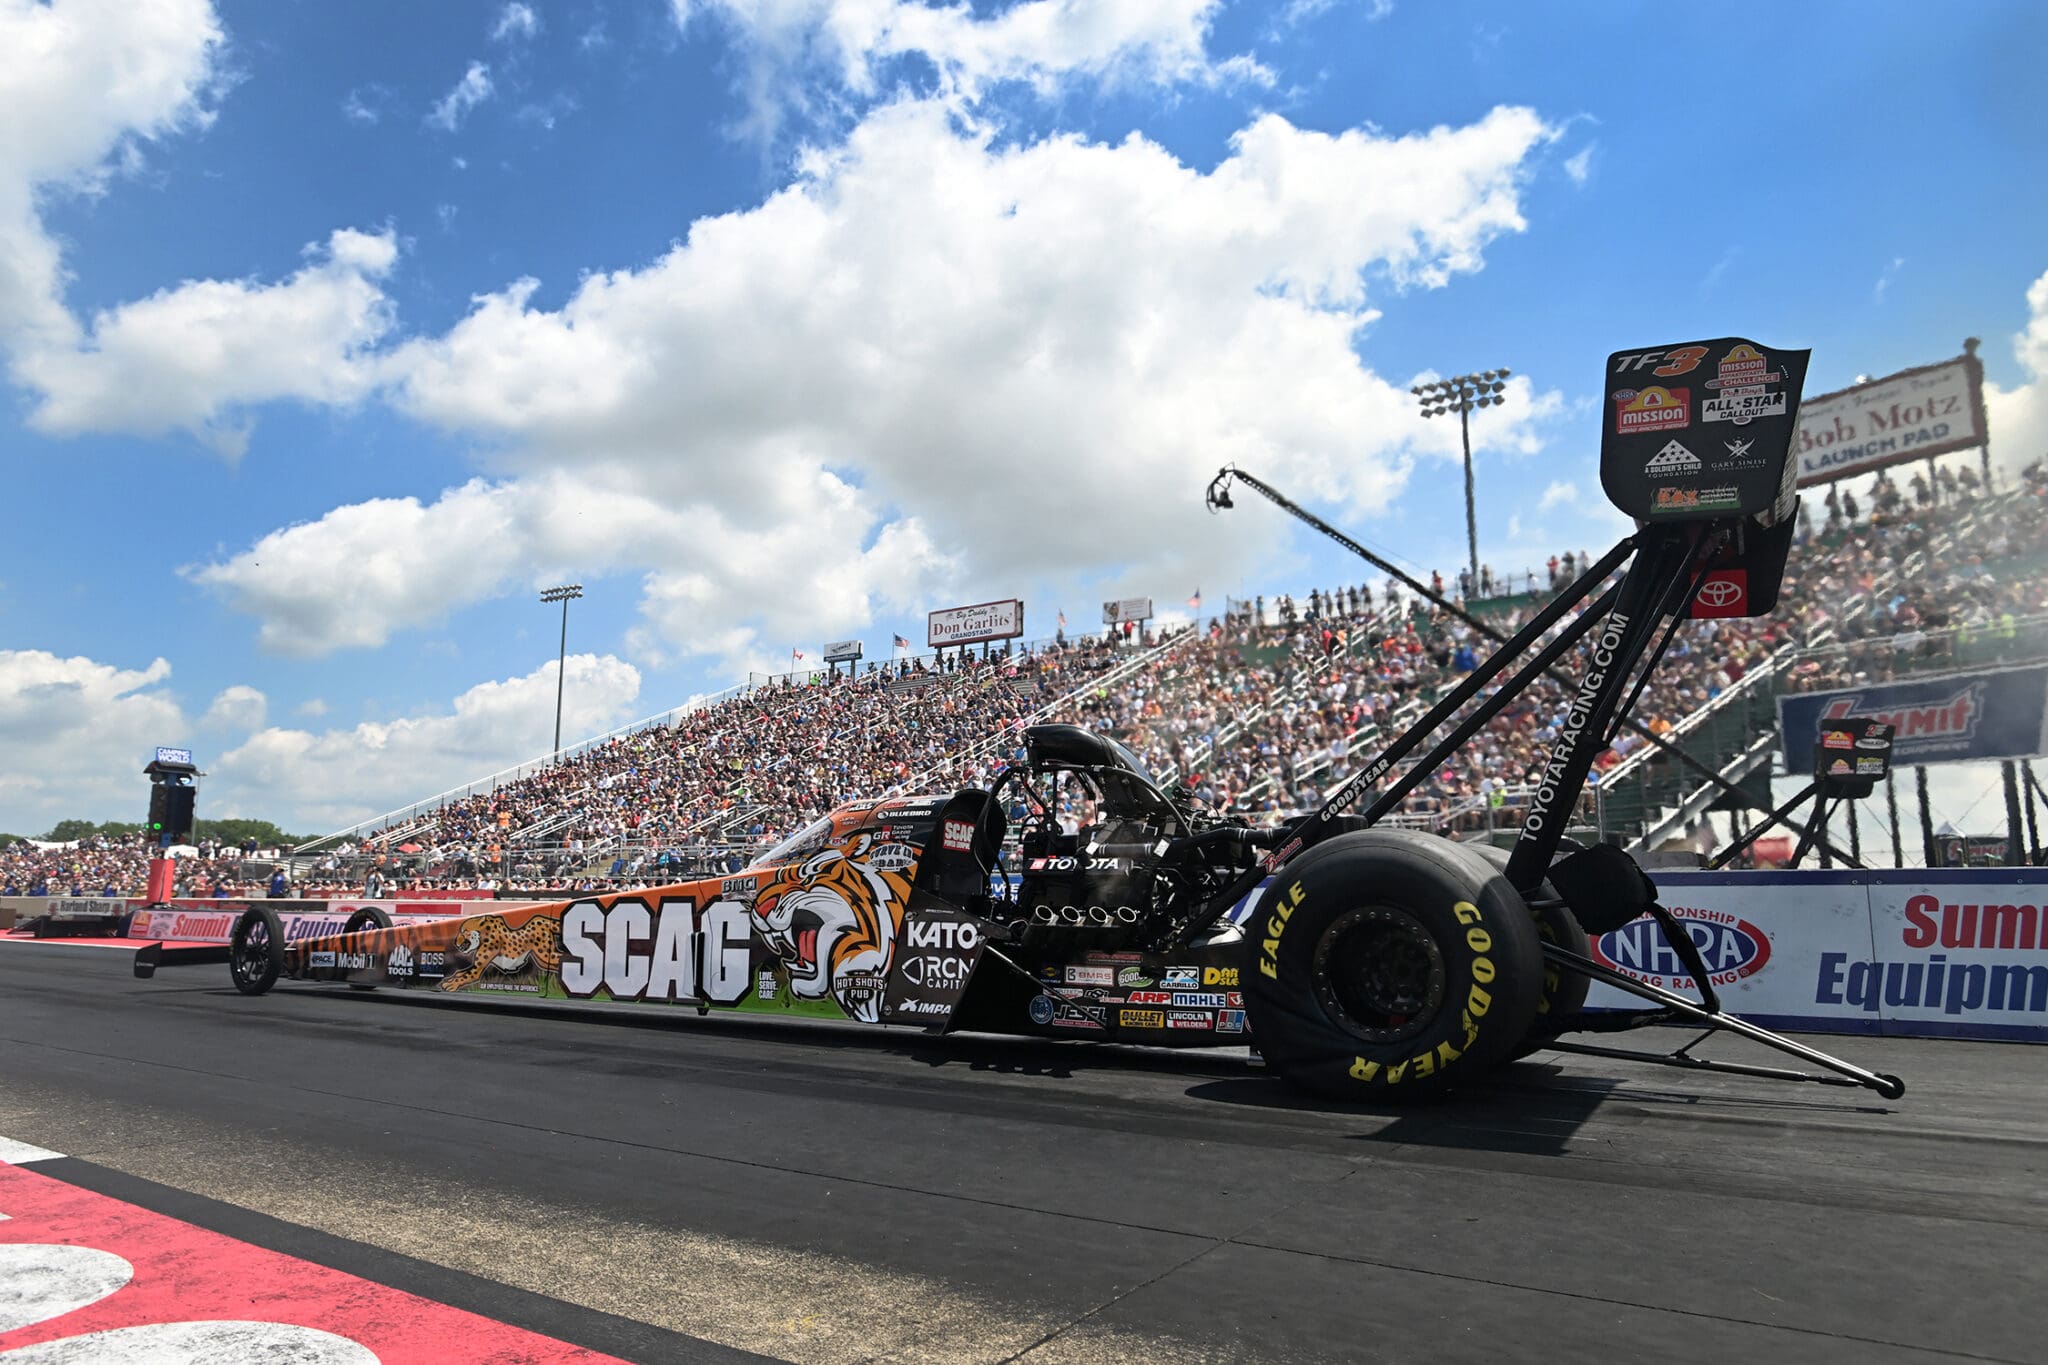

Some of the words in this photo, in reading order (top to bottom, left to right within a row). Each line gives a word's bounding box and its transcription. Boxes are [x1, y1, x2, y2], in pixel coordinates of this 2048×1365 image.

[1616, 346, 1709, 377] TF3
[1724, 375, 1777, 386] CHALLENGE
[1720, 408, 1765, 419] CALLOUT
[1867, 395, 1961, 436] Motz
[1804, 436, 1897, 472] LAUNCH
[1903, 422, 1950, 447] PAD
[1650, 464, 1682, 473] SOLDIER'S
[1683, 462, 1702, 470] CHILD
[1711, 461, 1734, 469] GARY
[1648, 470, 1699, 478] FOUNDATION
[955, 611, 967, 619] Big
[968, 608, 988, 617] Daddy
[933, 623, 960, 636] Don
[950, 628, 993, 640] GRANDSTAND
[1519, 611, 1631, 842] TOYOTARACING.COM
[158, 754, 190, 764] WORLD
[1320, 758, 1390, 823] GOODYEAR
[889, 810, 932, 818] BLUEBIRD
[873, 831, 891, 840] GR
[945, 822, 975, 842] SCAG
[1048, 858, 1120, 870] TOOTA
[172, 914, 231, 938] Summit
[1902, 894, 2048, 951] Sum
[907, 921, 978, 950] KATO
[1259, 880, 1308, 980] EAGLE
[561, 900, 751, 1002] SCAG
[1614, 921, 1744, 974] NHRA
[338, 952, 366, 969] Mobil
[388, 945, 414, 967] MAC
[421, 952, 445, 965] BOSS
[388, 967, 414, 976] TOOLS
[837, 978, 852, 989] HOT
[855, 978, 884, 989] SHOTS
[926, 978, 966, 989] CAPIT
[1672, 971, 1737, 990] RANG
[851, 989, 869, 999] PUB
[1129, 993, 1171, 1003] ARP
[1349, 900, 1496, 1085] GOODYEAR
[1174, 994, 1226, 1006] MAHLE
[1122, 1011, 1162, 1021] BULLET
[1168, 1012, 1205, 1020] LINCOLN
[1176, 1020, 1208, 1028] WELDERS
